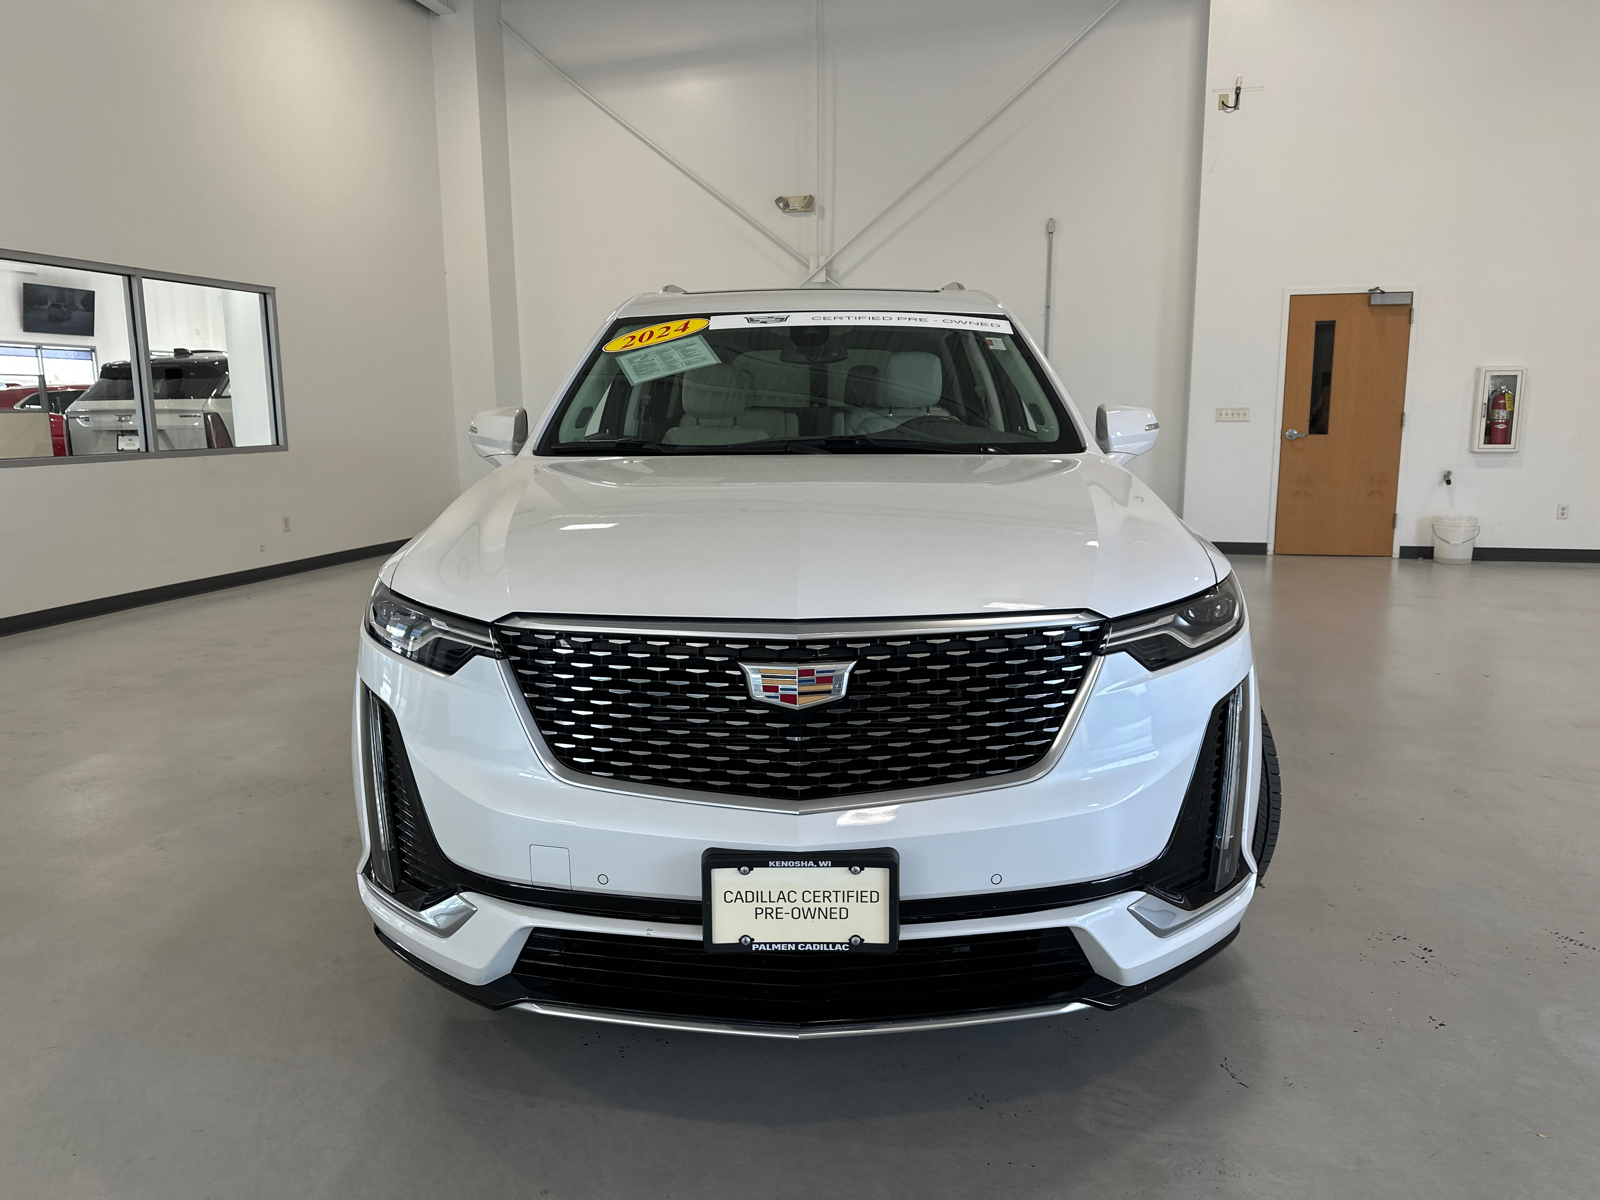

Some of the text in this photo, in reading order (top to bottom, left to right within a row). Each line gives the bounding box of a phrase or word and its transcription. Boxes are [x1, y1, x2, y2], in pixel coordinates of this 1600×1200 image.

[942, 318, 1001, 329] OWNED
[620, 320, 690, 349] 2024
[768, 860, 817, 868] KENOSHA,
[723, 890, 880, 903] CADILLAC CERTIFIED
[754, 907, 849, 920] PRE-OWNED
[752, 943, 850, 951] PALMEN CADILLAC
